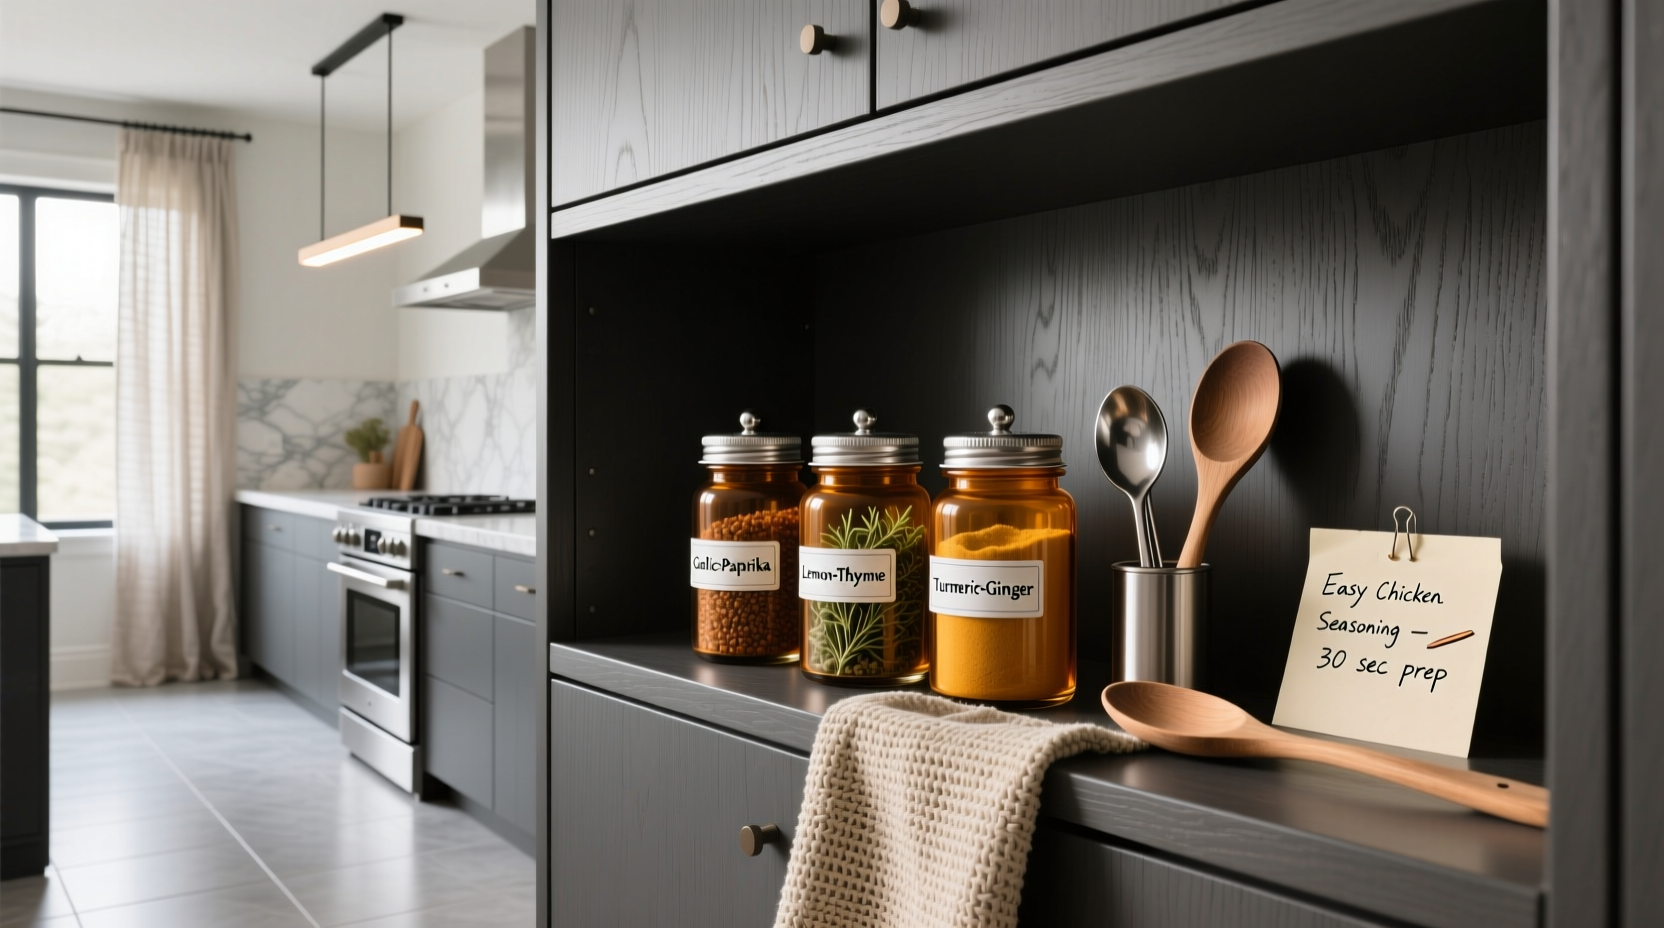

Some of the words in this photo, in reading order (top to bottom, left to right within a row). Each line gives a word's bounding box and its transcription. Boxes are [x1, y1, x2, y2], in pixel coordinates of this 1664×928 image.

[933, 577, 1034, 600] Turmeric-Ginger
[1322, 572, 1368, 608] Easy
[1376, 581, 1444, 604] Chicken
[1316, 611, 1400, 648] Seasoning
[1316, 647, 1347, 669] 30
[1356, 657, 1388, 675] sec
[1399, 664, 1448, 693] prep
